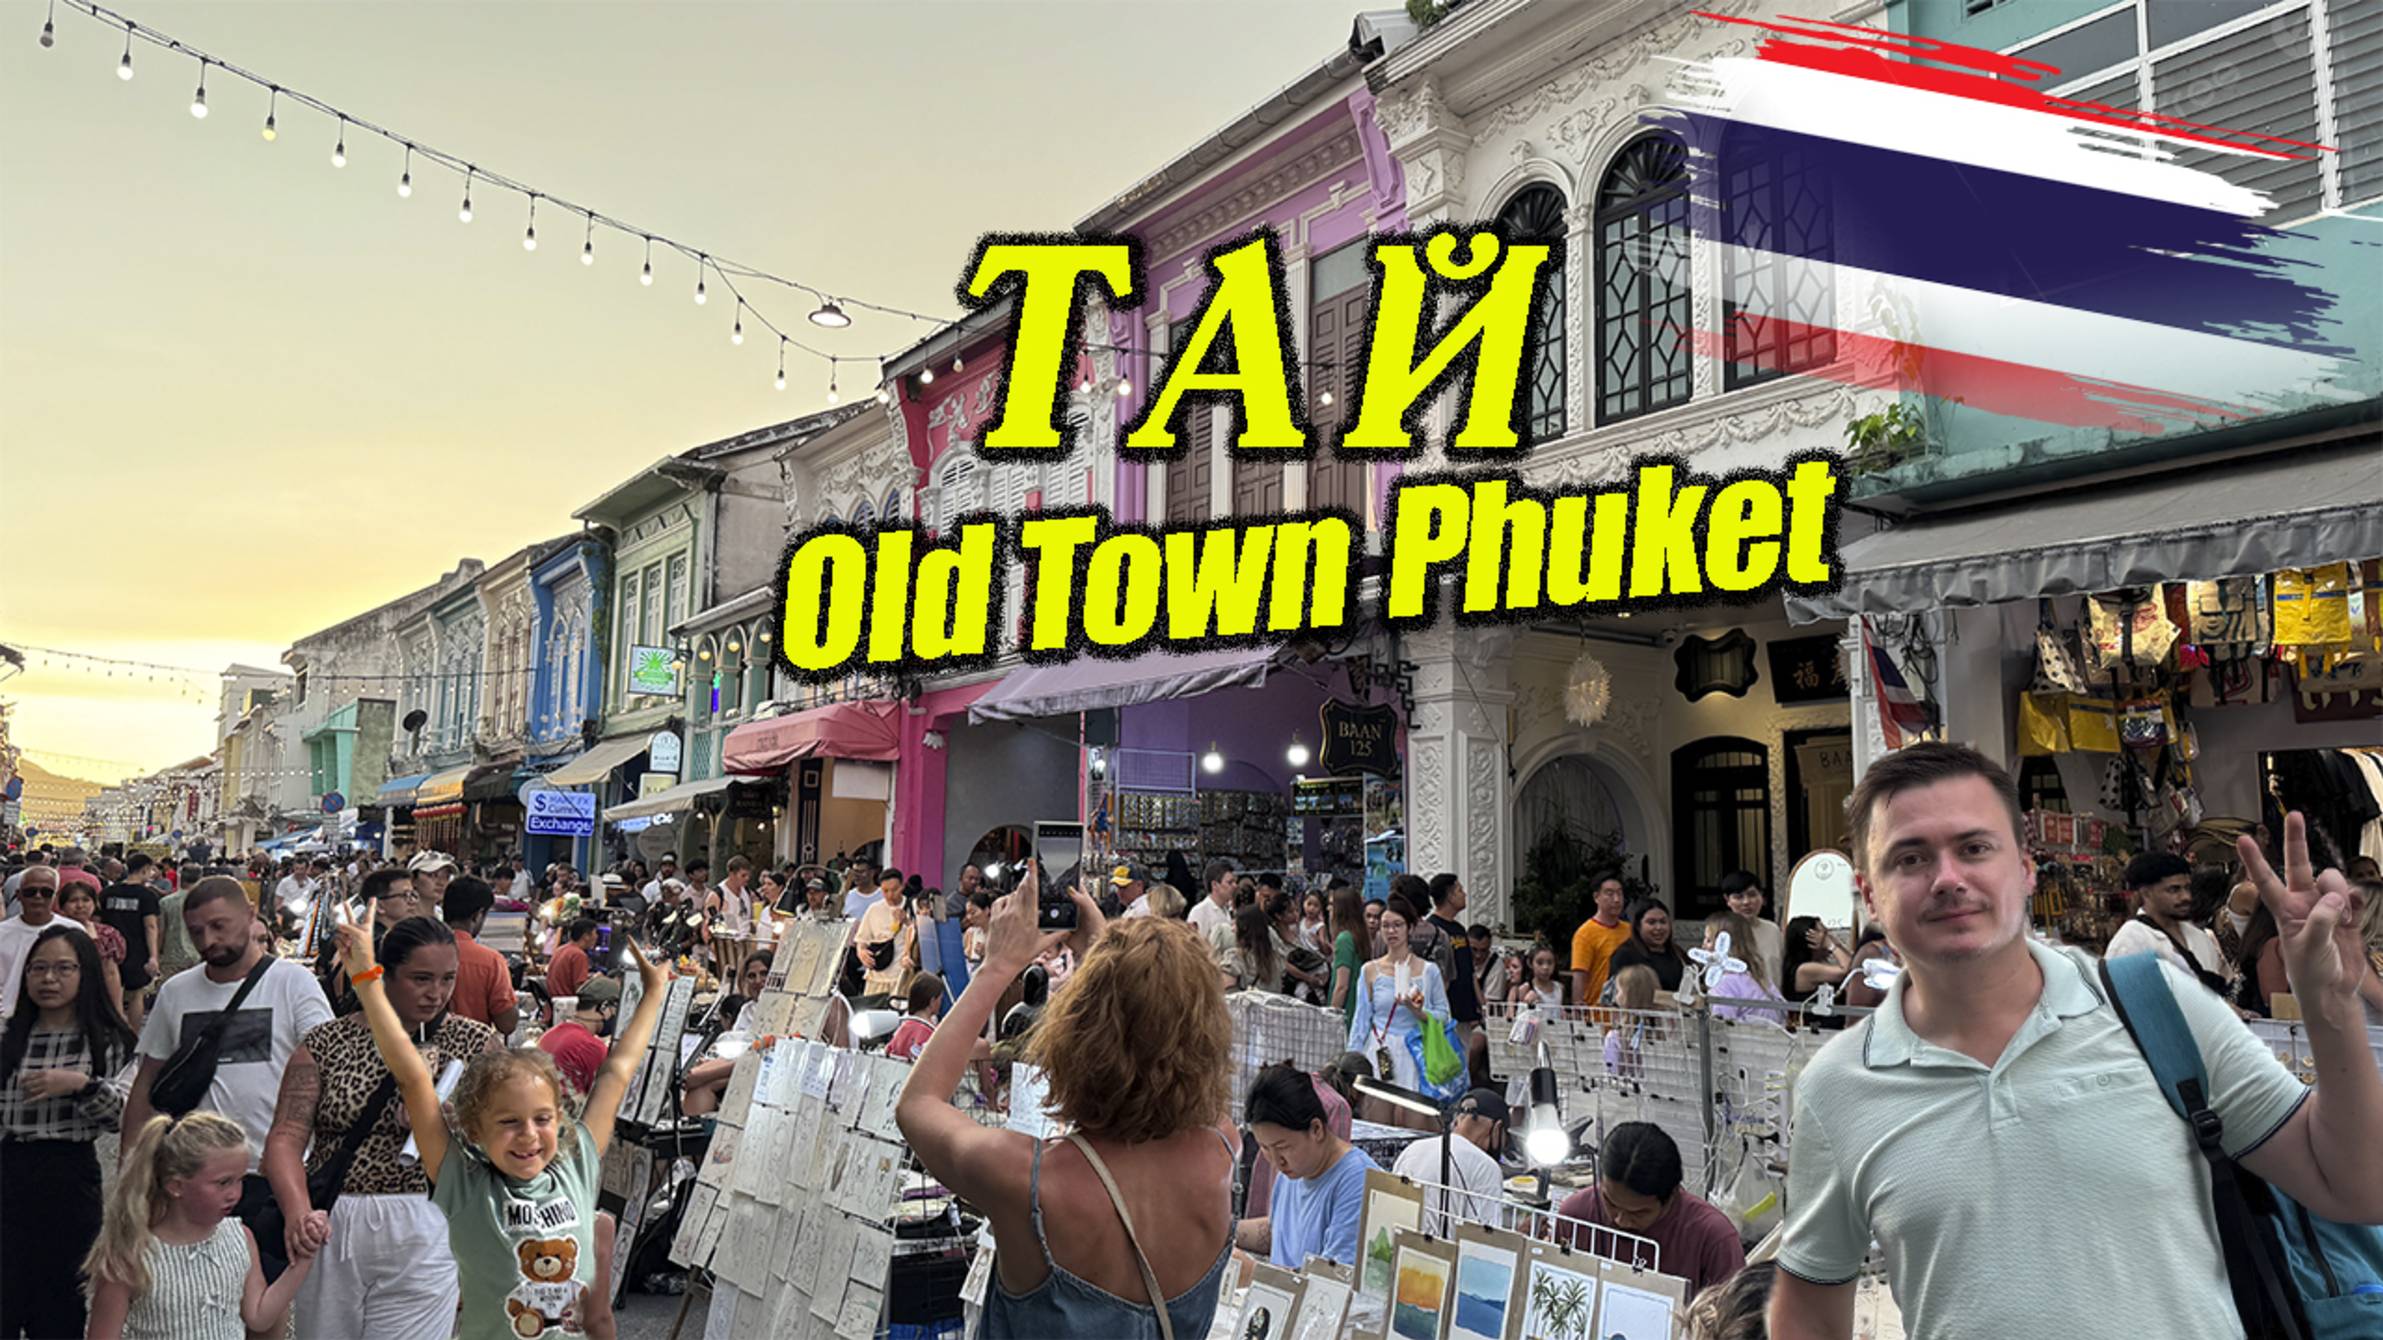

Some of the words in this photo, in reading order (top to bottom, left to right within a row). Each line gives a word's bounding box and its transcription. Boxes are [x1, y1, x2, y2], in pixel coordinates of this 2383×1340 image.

[1339, 721, 1381, 739] BAAN
[1351, 741, 1373, 756] 125
[547, 804, 592, 816] Curreny
[530, 816, 593, 834] Exchange
